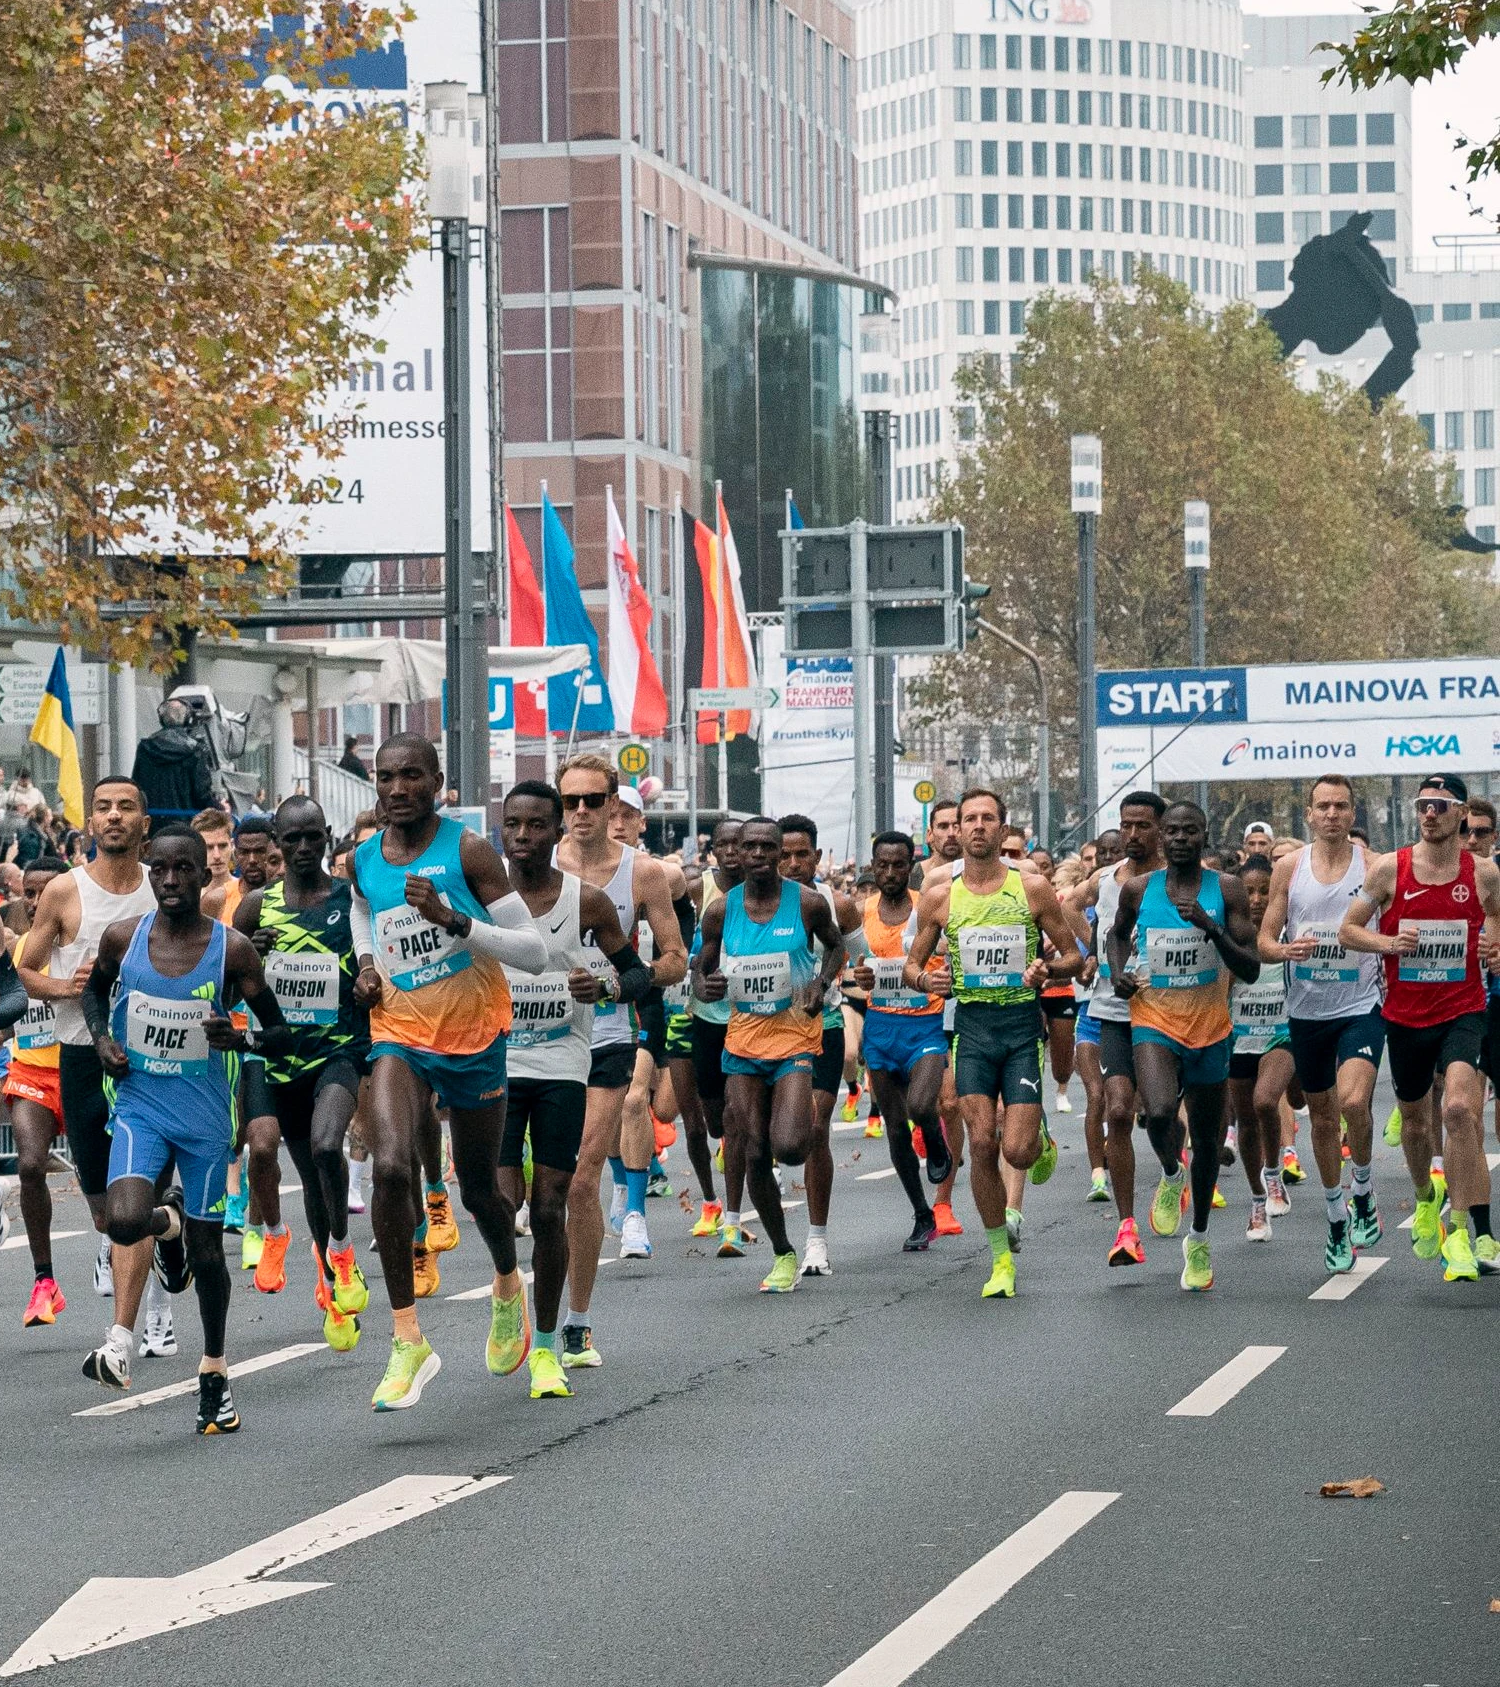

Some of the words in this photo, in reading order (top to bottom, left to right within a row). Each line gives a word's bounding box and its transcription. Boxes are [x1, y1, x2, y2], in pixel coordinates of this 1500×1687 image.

[988, 0, 1048, 23] ING
[1285, 677, 1428, 705] MAINOVA
[1439, 675, 1500, 700] FRA
[1109, 681, 1230, 716] START
[1254, 739, 1356, 761] mainova
[1385, 733, 1461, 758] HOKA
[418, 865, 447, 877] HOKA
[773, 926, 795, 937] HOKA
[977, 933, 1020, 943] mainova
[1419, 927, 1462, 937] mainova
[400, 926, 442, 960] PACE
[976, 948, 1010, 966] PACE
[1165, 949, 1199, 967] PACE
[283, 961, 332, 973] mainova
[742, 961, 784, 971] mainova
[411, 961, 451, 988] HOKA
[978, 976, 1008, 987] HOKA
[1168, 976, 1200, 987] HOKA
[1311, 971, 1341, 981] HOKA
[1417, 971, 1449, 982] HOKA
[275, 978, 327, 998] BENSON
[512, 981, 565, 994] mainova
[743, 976, 775, 995] PACE
[750, 1002, 777, 1013] HOKA
[885, 999, 912, 1008] HOKA
[1240, 1001, 1284, 1017] MESERET
[149, 1005, 204, 1021] mainova
[143, 1025, 189, 1050] PACE
[1249, 1026, 1277, 1036] HOKA
[143, 1059, 184, 1075] HOKA
[7, 1080, 46, 1100] INEOS
